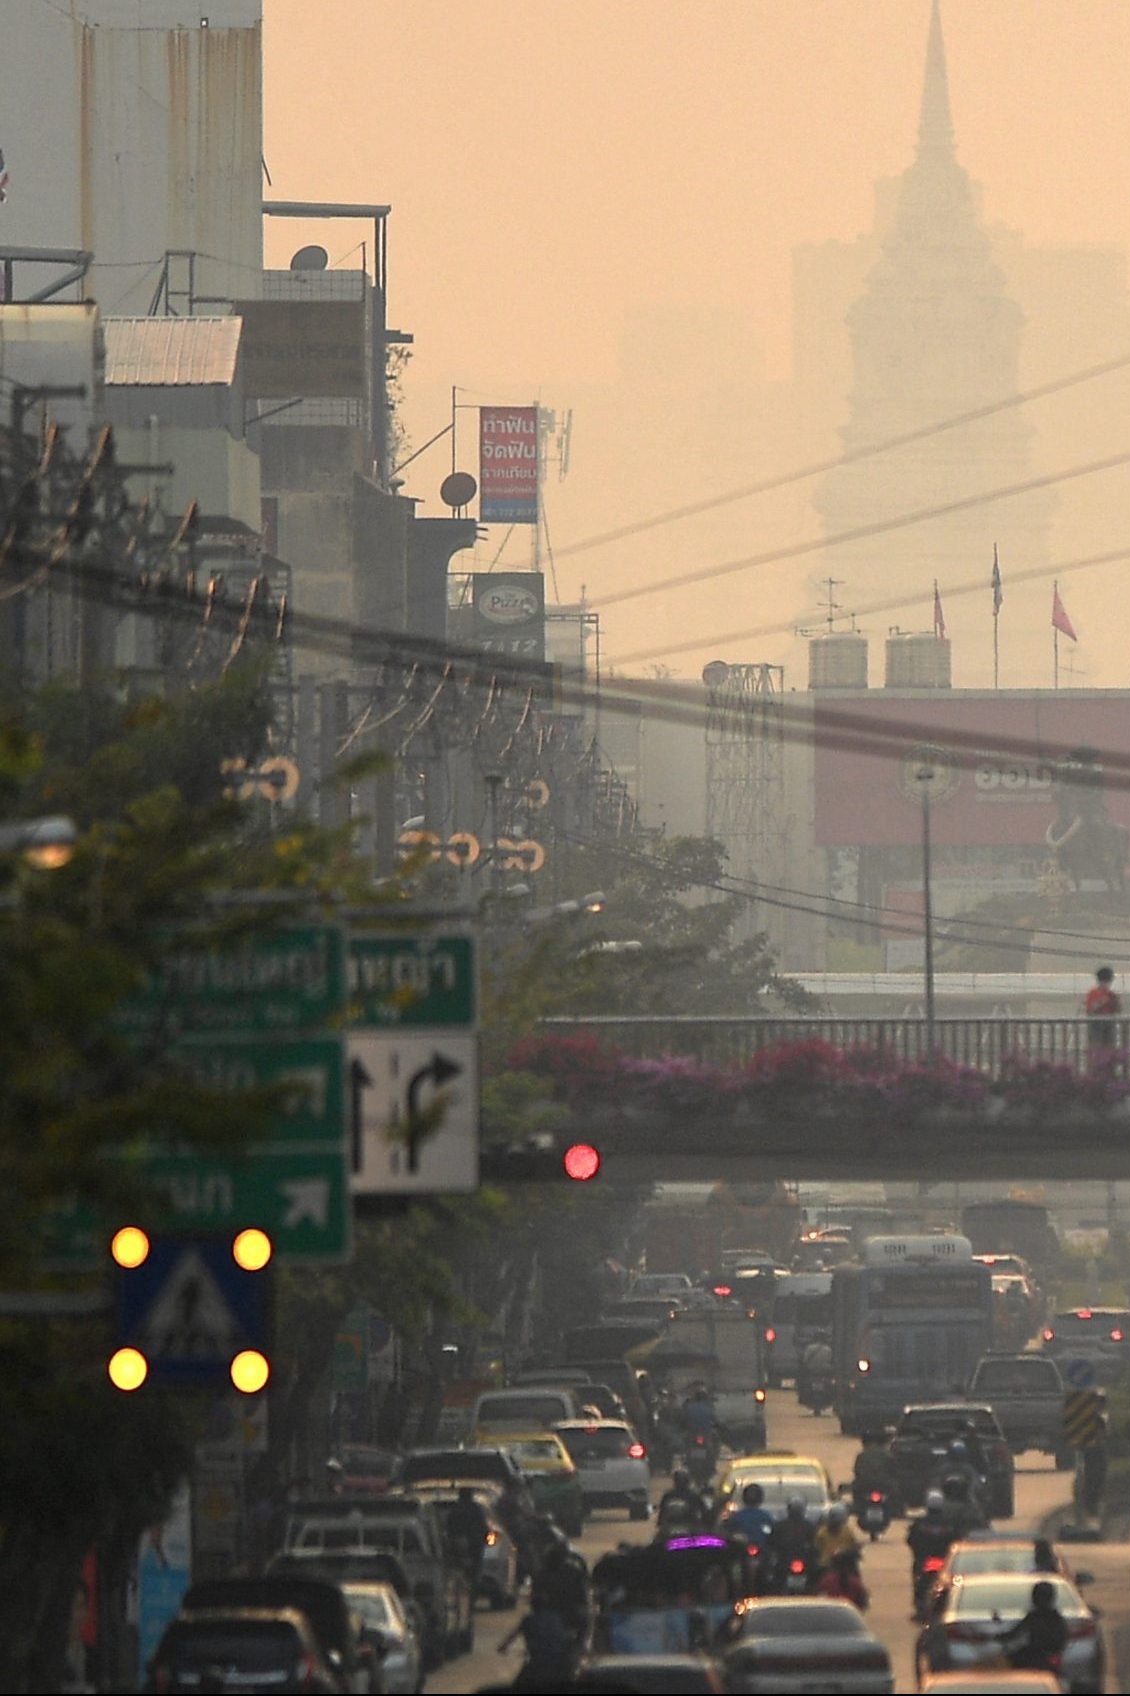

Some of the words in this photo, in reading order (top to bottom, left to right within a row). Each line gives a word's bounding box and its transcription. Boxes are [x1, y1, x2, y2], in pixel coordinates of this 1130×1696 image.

[483, 414, 535, 433] ทำฟัน
[483, 440, 536, 458] จัดฟัน
